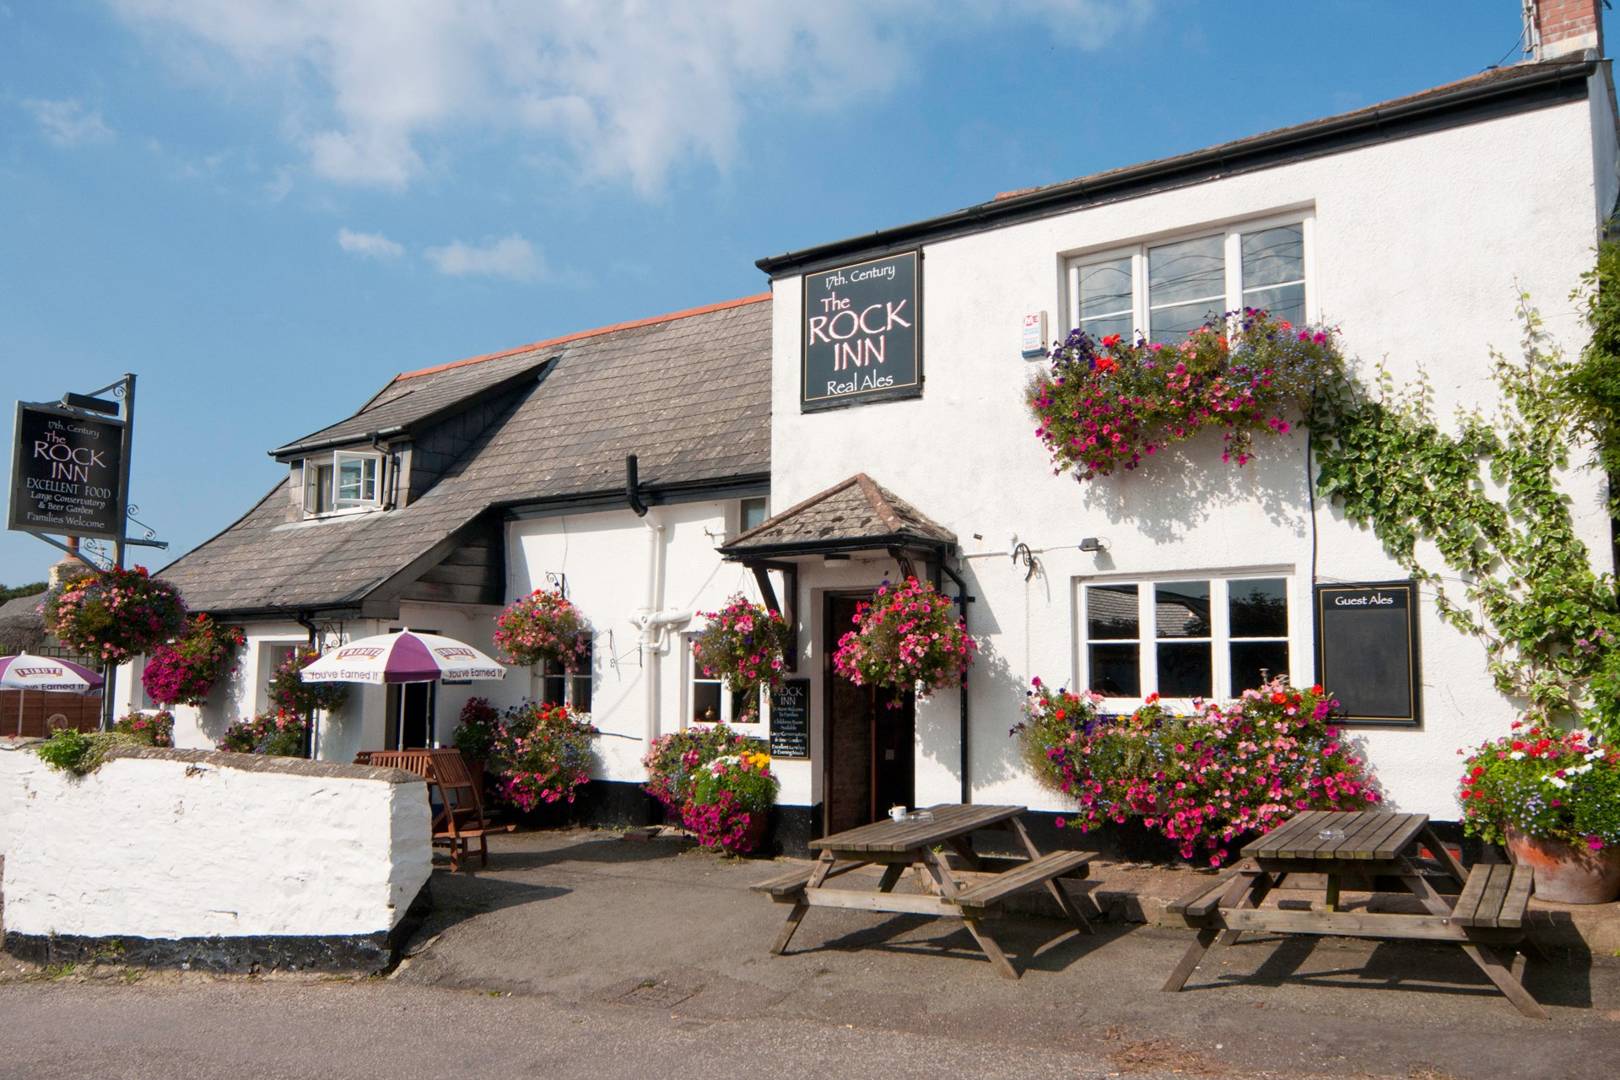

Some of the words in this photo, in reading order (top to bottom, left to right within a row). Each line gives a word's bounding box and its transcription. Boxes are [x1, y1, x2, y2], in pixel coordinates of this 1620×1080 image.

[850, 264, 896, 282] Century
[820, 291, 851, 313] The
[809, 299, 912, 346] ROCK
[834, 335, 885, 371] INN
[827, 372, 858, 396] Real
[860, 368, 894, 391] Ales
[44, 431, 67, 444] The
[67, 424, 100, 439] Century
[34, 440, 107, 468] ROCK
[51, 462, 89, 483] INN
[26, 477, 79, 495] EXCELLENT
[85, 486, 111, 499] FOOD
[30, 490, 53, 501] Large
[54, 494, 106, 510] Conservatory
[47, 502, 64, 511] Beer
[66, 505, 94, 515] Garden
[27, 511, 64, 524] Families
[65, 515, 105, 529] Welcome
[1335, 596, 1367, 606] Guest
[1368, 592, 1394, 605] Ales
[340, 669, 370, 680] Earned
[470, 668, 496, 677] Earned
[780, 697, 796, 705] INN
